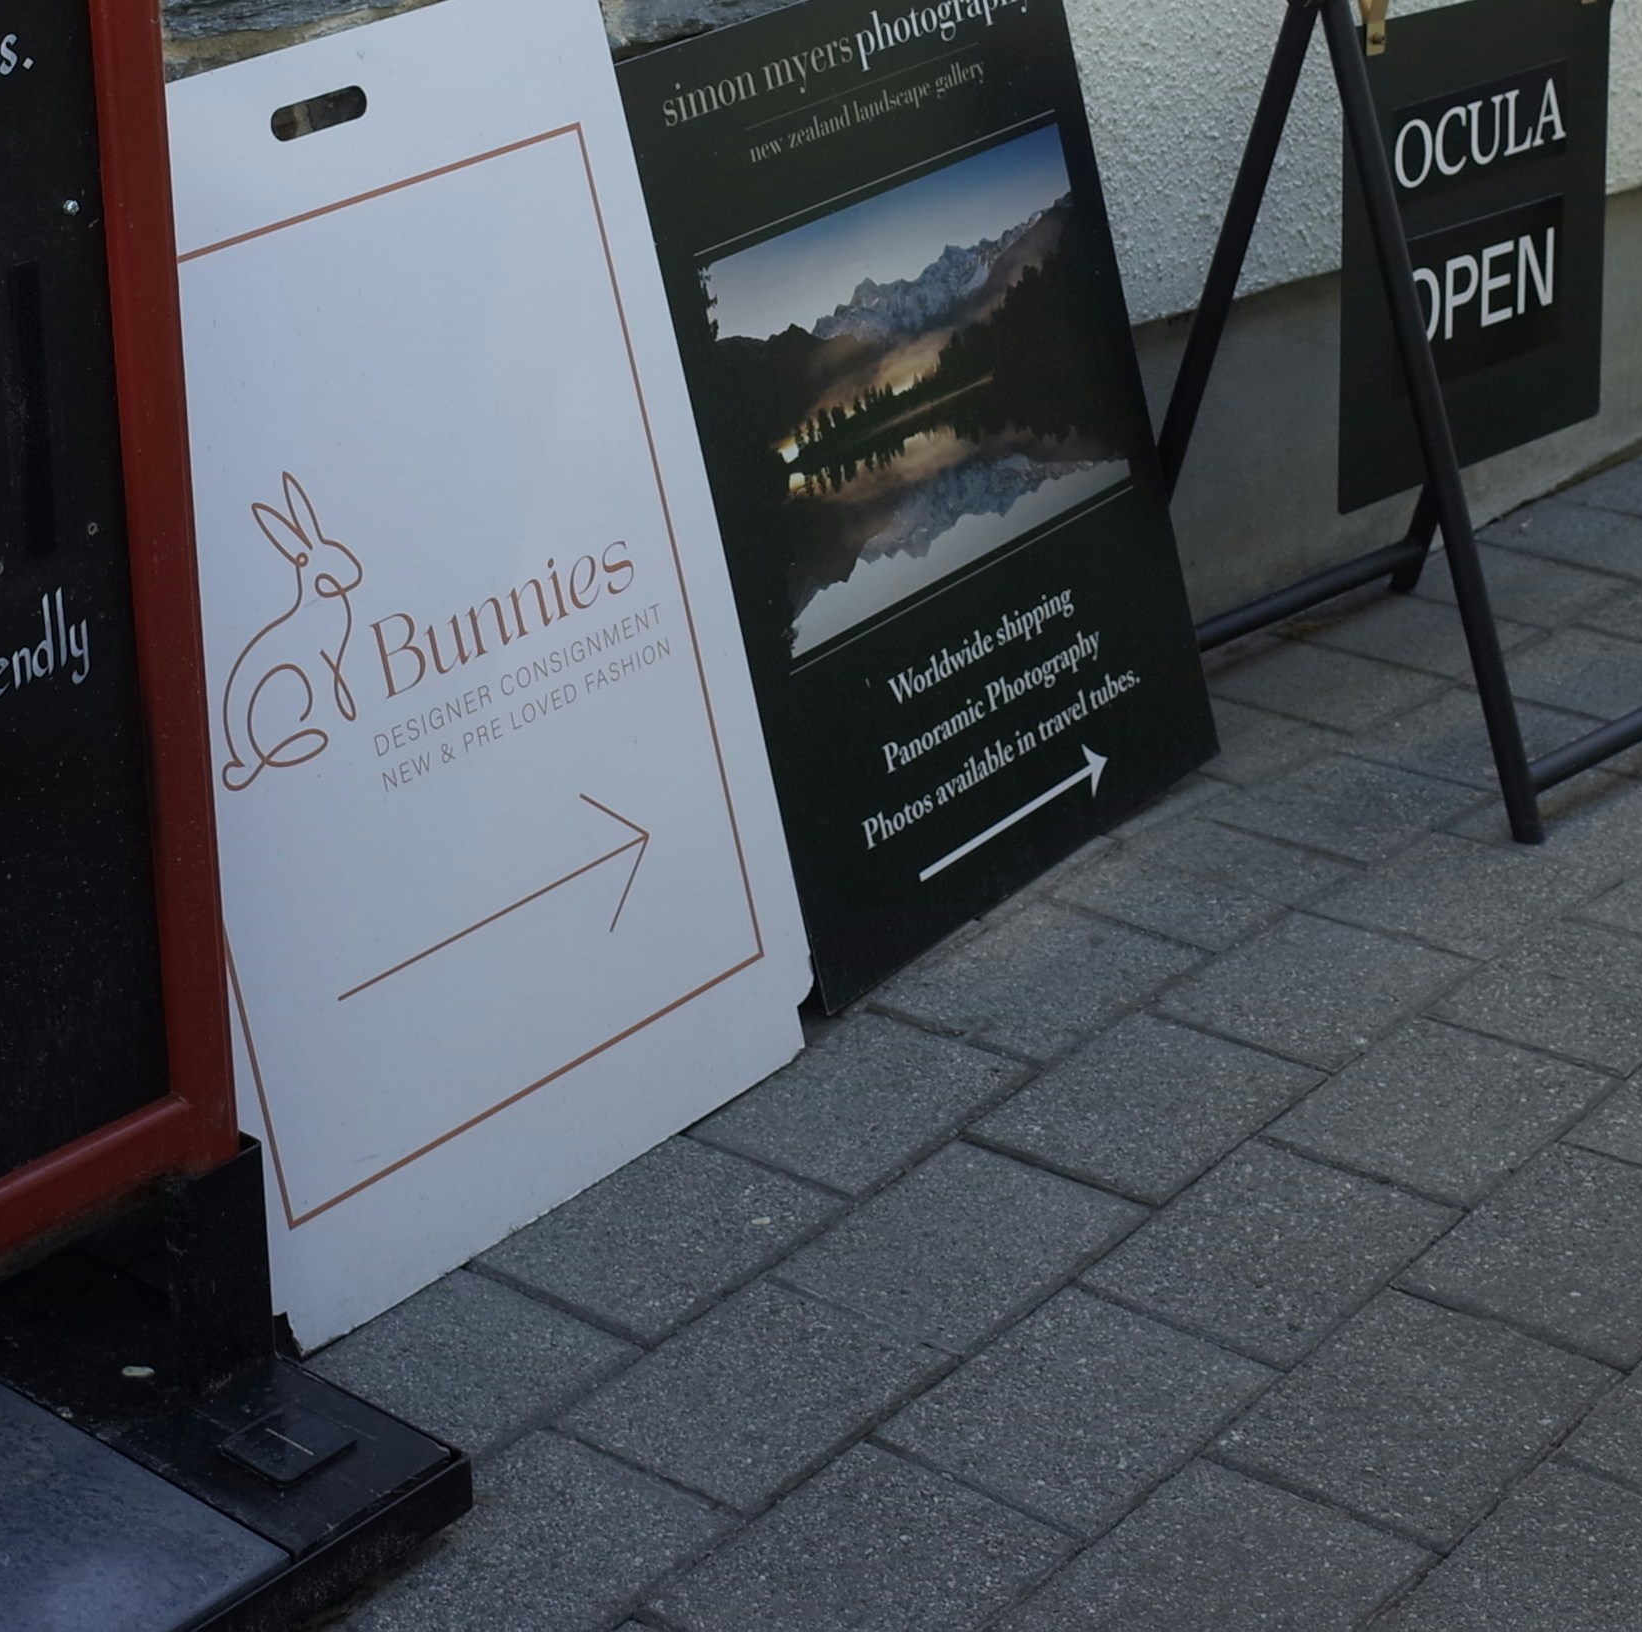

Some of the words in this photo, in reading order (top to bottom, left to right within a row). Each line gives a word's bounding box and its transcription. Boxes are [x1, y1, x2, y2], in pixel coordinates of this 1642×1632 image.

[662, 70, 758, 128] simon
[761, 35, 854, 94] myers
[748, 137, 784, 163] new
[787, 105, 852, 149] zealand
[855, 78, 931, 123] landscape
[933, 60, 986, 100] gallery
[1394, 77, 1567, 189] OCULA
[369, 540, 636, 700] Bunnies
[373, 685, 494, 758] DESIGNER
[499, 603, 663, 697] CONSIGNMENT
[886, 629, 995, 705] Worldwide
[996, 588, 1076, 646] shipping
[381, 754, 434, 793] NEW
[439, 741, 457, 766] &
[462, 716, 505, 755] PRE
[512, 682, 579, 731] LOVED
[584, 637, 673, 696] FASHION
[861, 794, 934, 851] Photos
[935, 739, 1016, 808] available
[1014, 726, 1038, 757] in
[1037, 689, 1090, 742] travel
[1089, 668, 1143, 710] tubes.
[881, 698, 987, 774] Panoramic
[984, 628, 1102, 713] Photography
